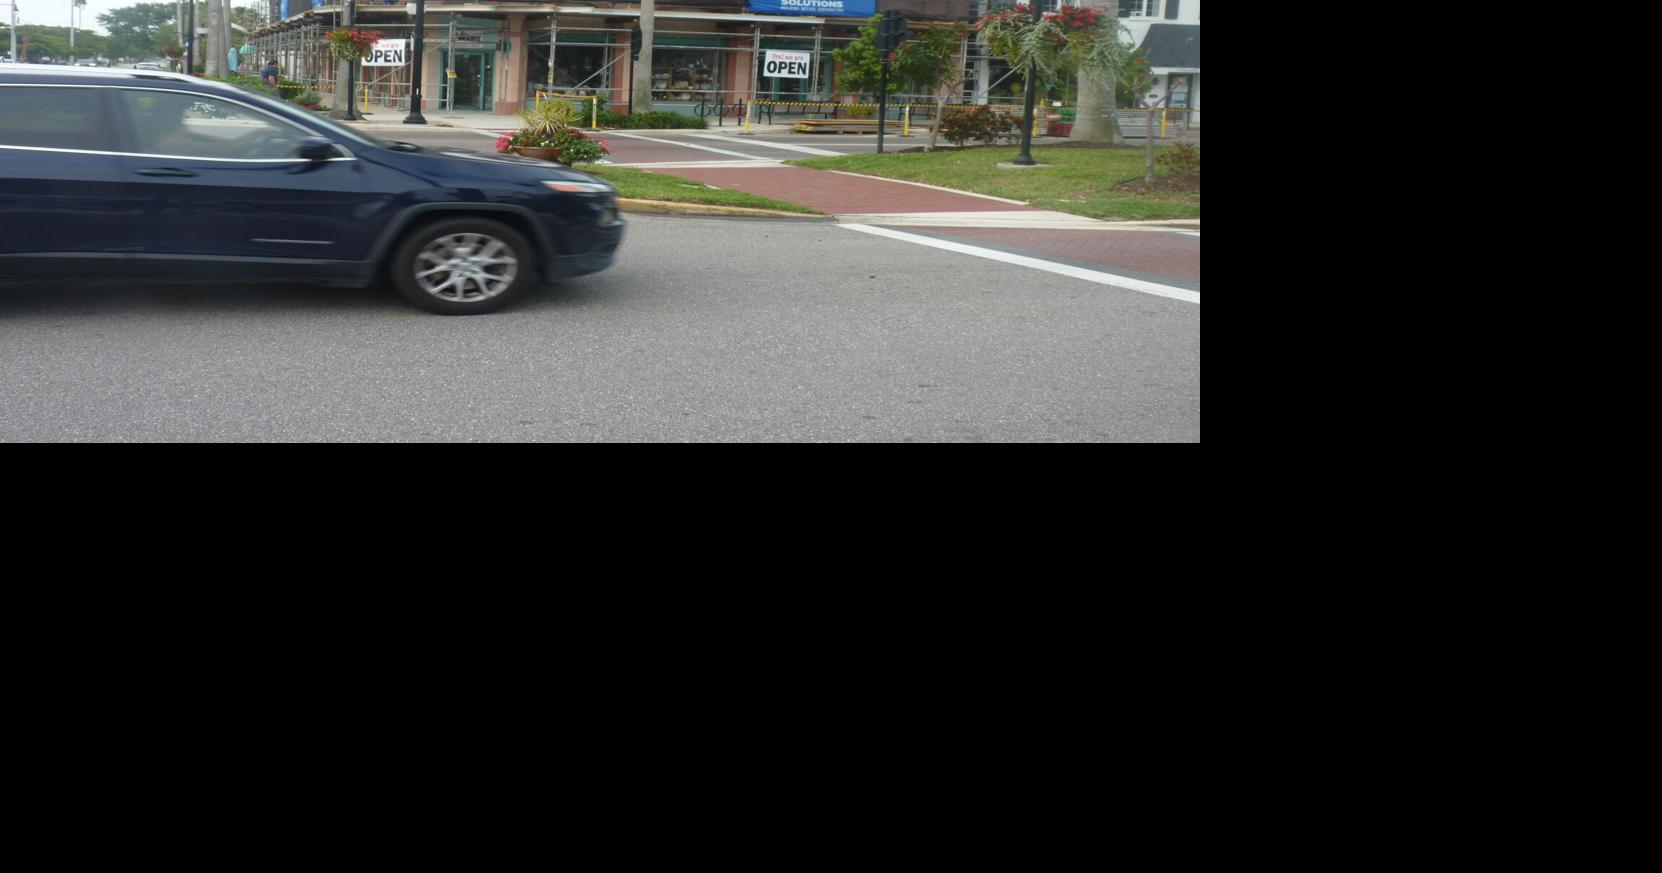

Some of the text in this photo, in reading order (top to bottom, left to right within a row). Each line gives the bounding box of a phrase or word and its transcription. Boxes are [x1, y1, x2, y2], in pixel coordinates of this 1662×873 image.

[781, 0, 844, 8] SOLUTIONS
[364, 49, 403, 63] OPEN
[767, 60, 807, 75] OPEN
